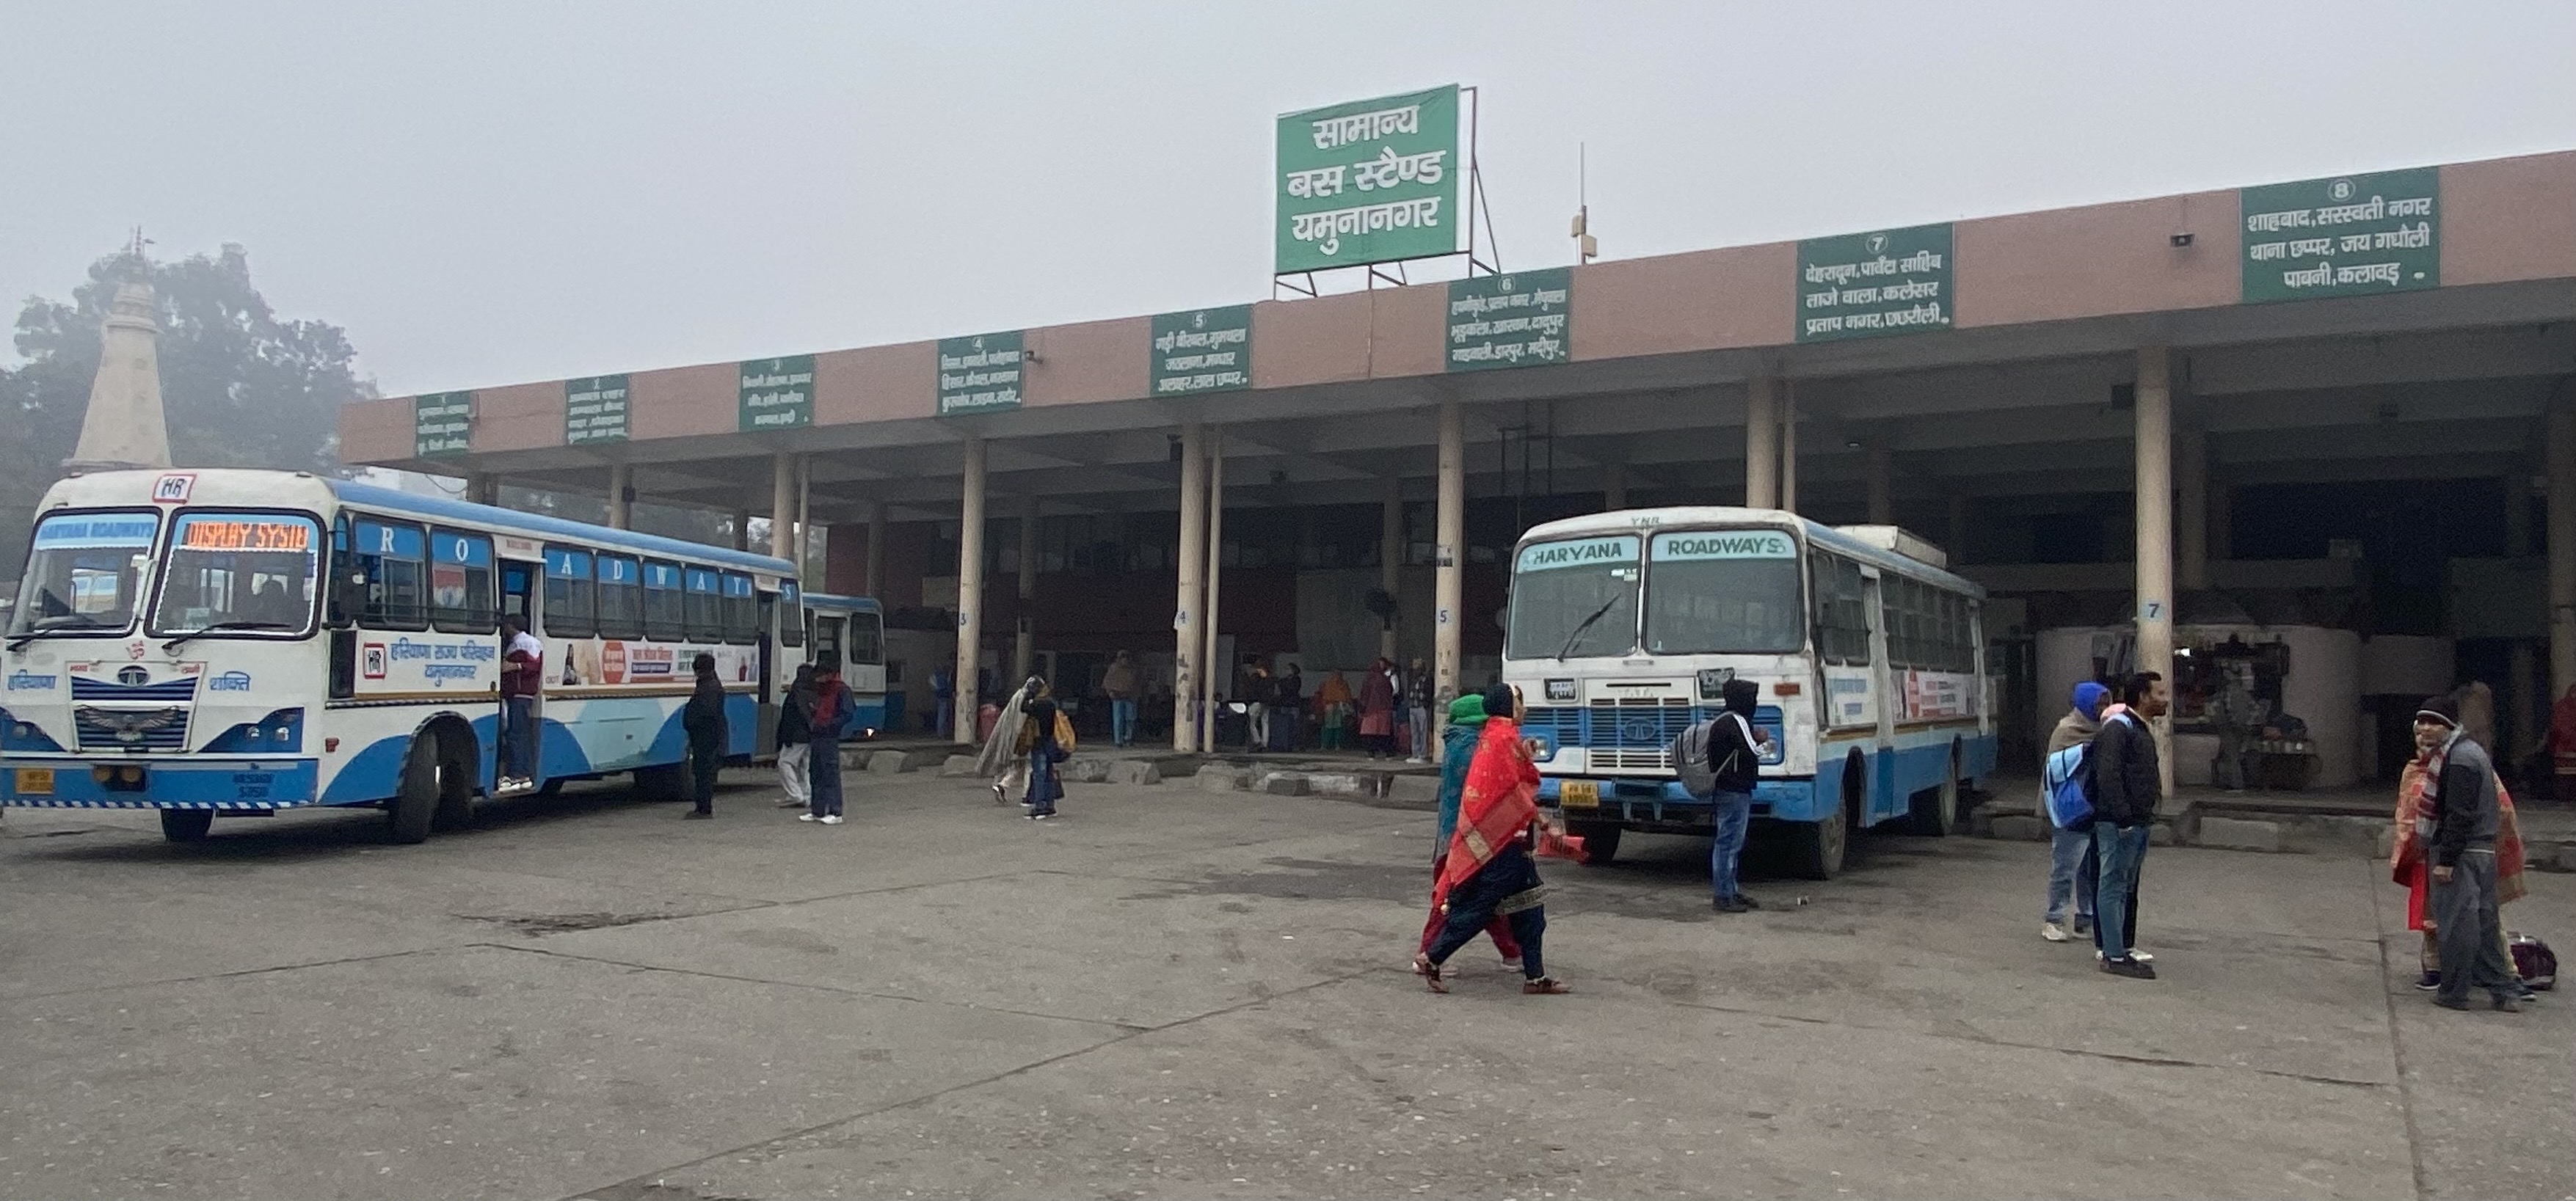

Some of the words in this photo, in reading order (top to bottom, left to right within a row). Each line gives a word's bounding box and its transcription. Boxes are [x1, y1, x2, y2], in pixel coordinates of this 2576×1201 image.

[1312, 105, 1420, 149] सामान्य
[1287, 165, 1346, 199] बस
[1353, 146, 1447, 191] स्टैण्ड
[2335, 183, 2349, 198] 8
[2388, 197, 2432, 217] नगर
[1291, 196, 1441, 255] यमुनानगर
[1872, 237, 1884, 251] 7
[2340, 234, 2371, 252] जय
[1502, 278, 1512, 291] 6
[1805, 316, 1842, 336] प्रताप
[161, 478, 186, 497] HR
[1532, 541, 1622, 564] HARYANA
[1668, 537, 1780, 556] ROADWAYS
[1439, 610, 1448, 623] 5
[2148, 604, 2160, 618] 7
